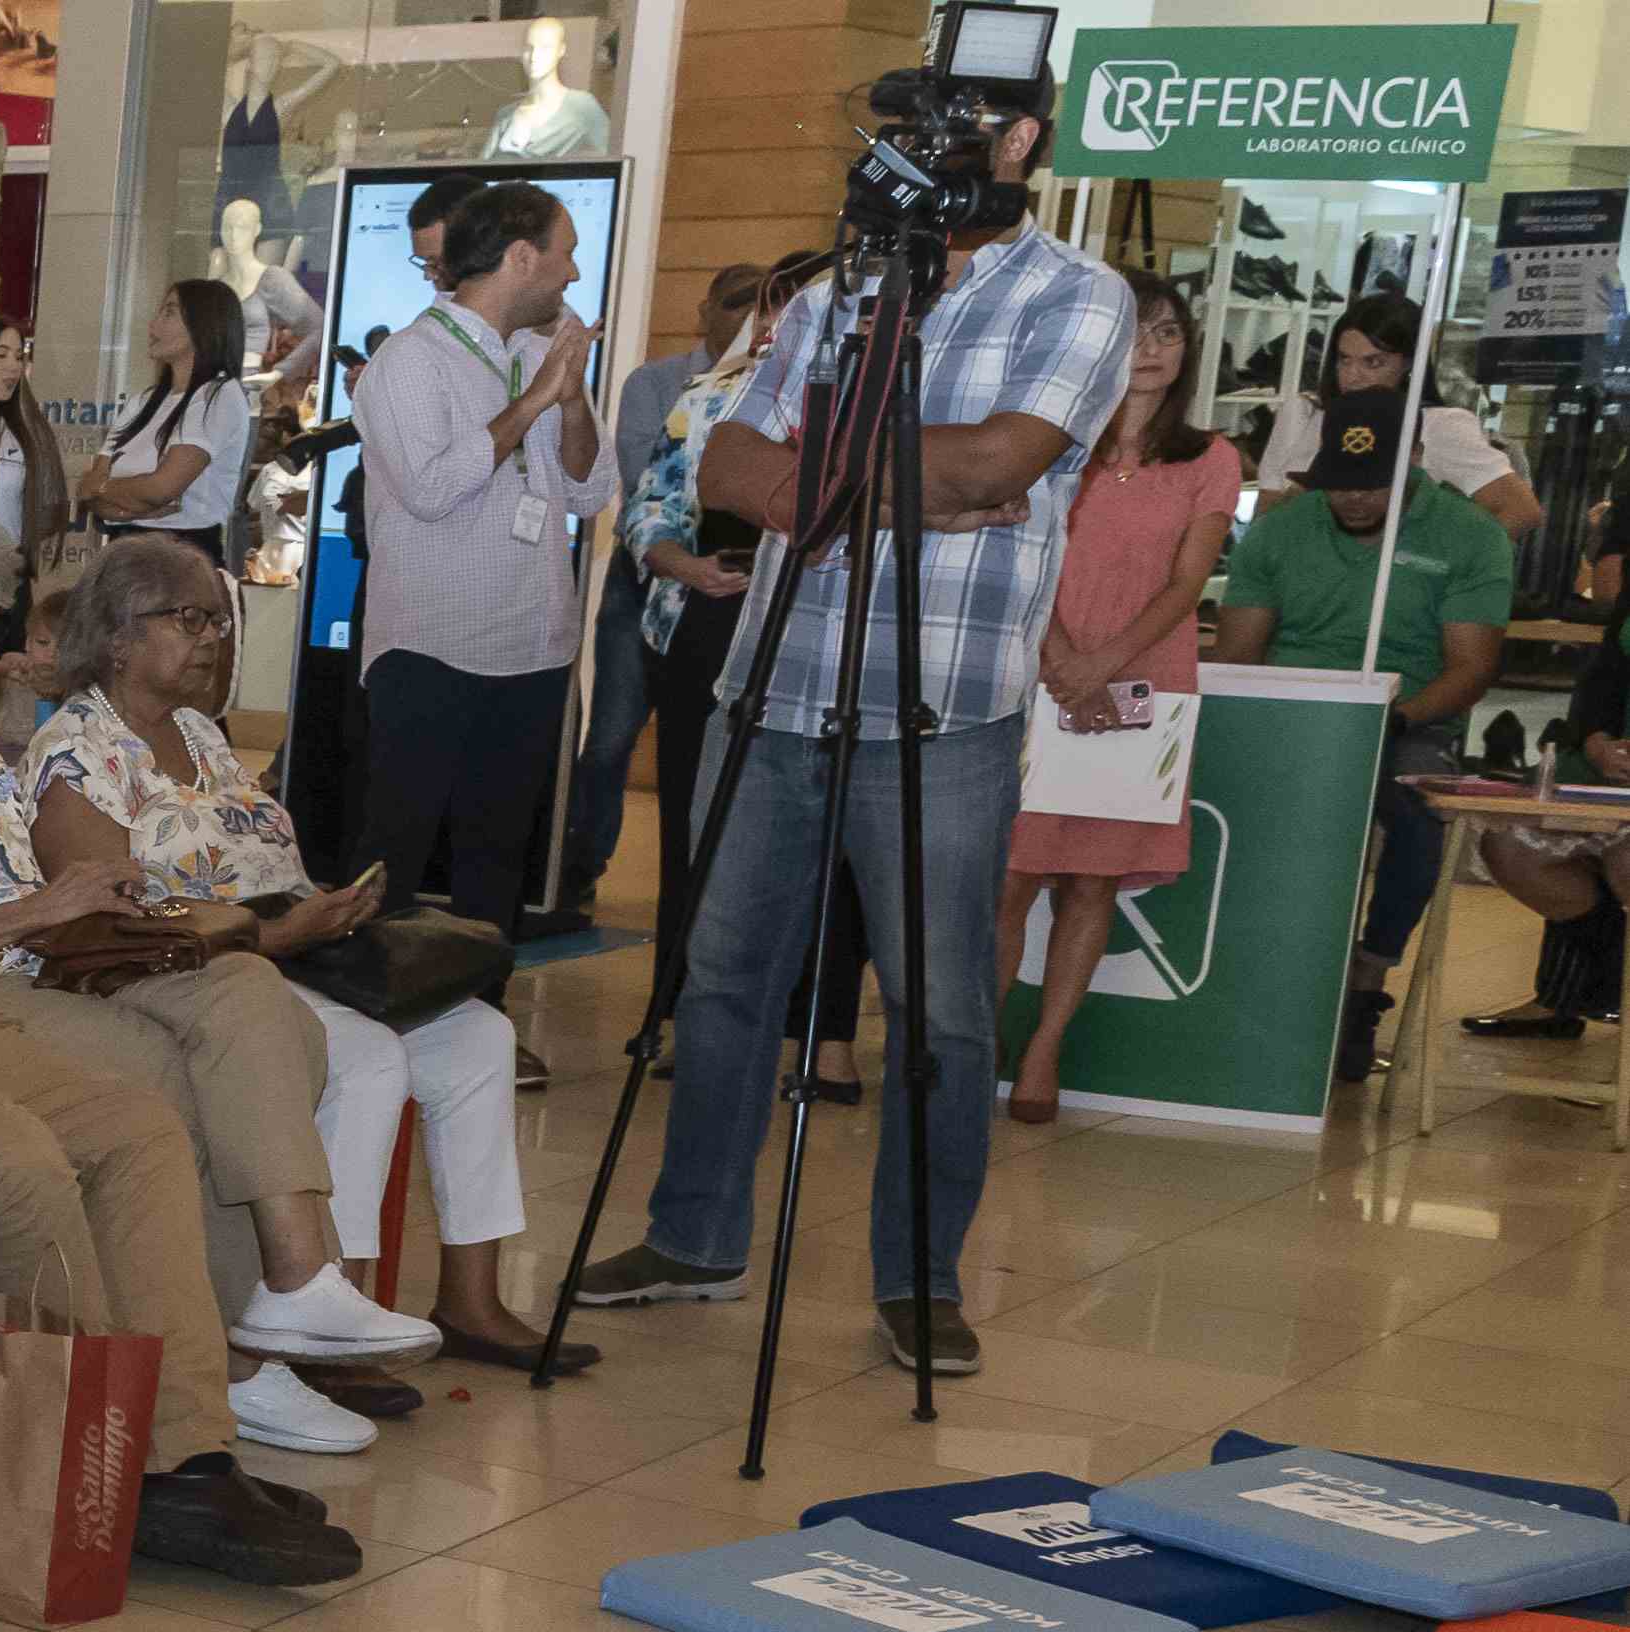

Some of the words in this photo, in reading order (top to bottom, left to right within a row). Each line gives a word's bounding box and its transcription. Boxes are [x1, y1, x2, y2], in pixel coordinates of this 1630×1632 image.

[1112, 75, 1472, 130] REFERENCIA
[1246, 136, 1381, 154] LABORATORIO
[1387, 136, 1467, 156] CLÍNICO
[1503, 308, 1548, 330] 20%
[74, 1423, 102, 1523] Santo
[90, 1405, 134, 1553] Domingo
[1279, 1466, 1388, 1495] Gold
[1020, 1520, 1099, 1545] Mil
[1399, 1498, 1551, 1537] Kinder
[804, 1550, 910, 1583] Gold
[1037, 1543, 1154, 1567] Kinder
[918, 1585, 1067, 1628] Kinder
